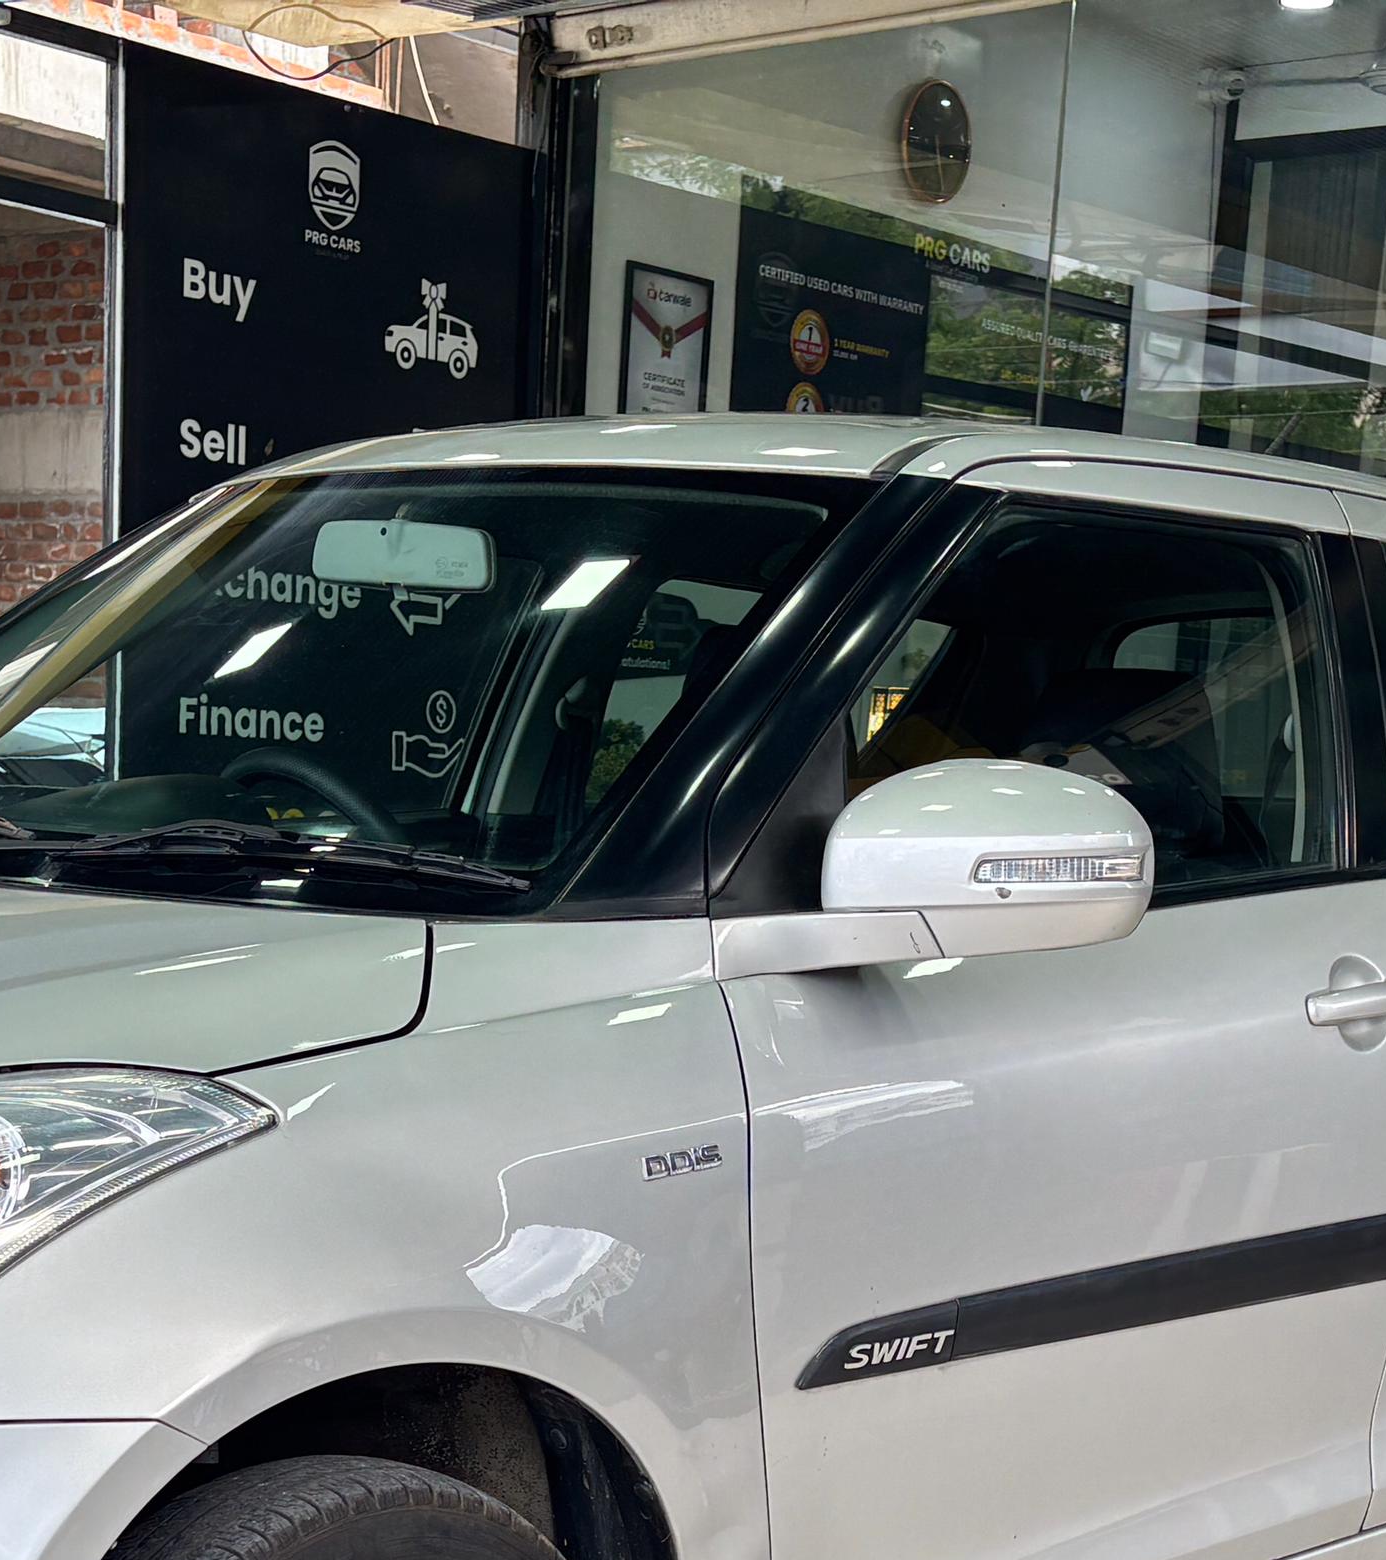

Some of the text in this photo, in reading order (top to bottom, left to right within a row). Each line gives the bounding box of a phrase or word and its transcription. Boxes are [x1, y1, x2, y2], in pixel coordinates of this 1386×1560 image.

[304, 229, 361, 253] PRG CARS
[915, 233, 947, 261] PRG
[949, 244, 990, 273] CARS
[182, 257, 257, 322] Buy
[759, 264, 925, 316] CERTIFIED USED CARS WITH WARRANTY
[1016, 327, 1045, 344] QUALIT
[179, 418, 247, 466] Sell
[214, 565, 362, 620] change
[178, 694, 325, 742] Finance
[843, 1329, 955, 1371] SWIFT
